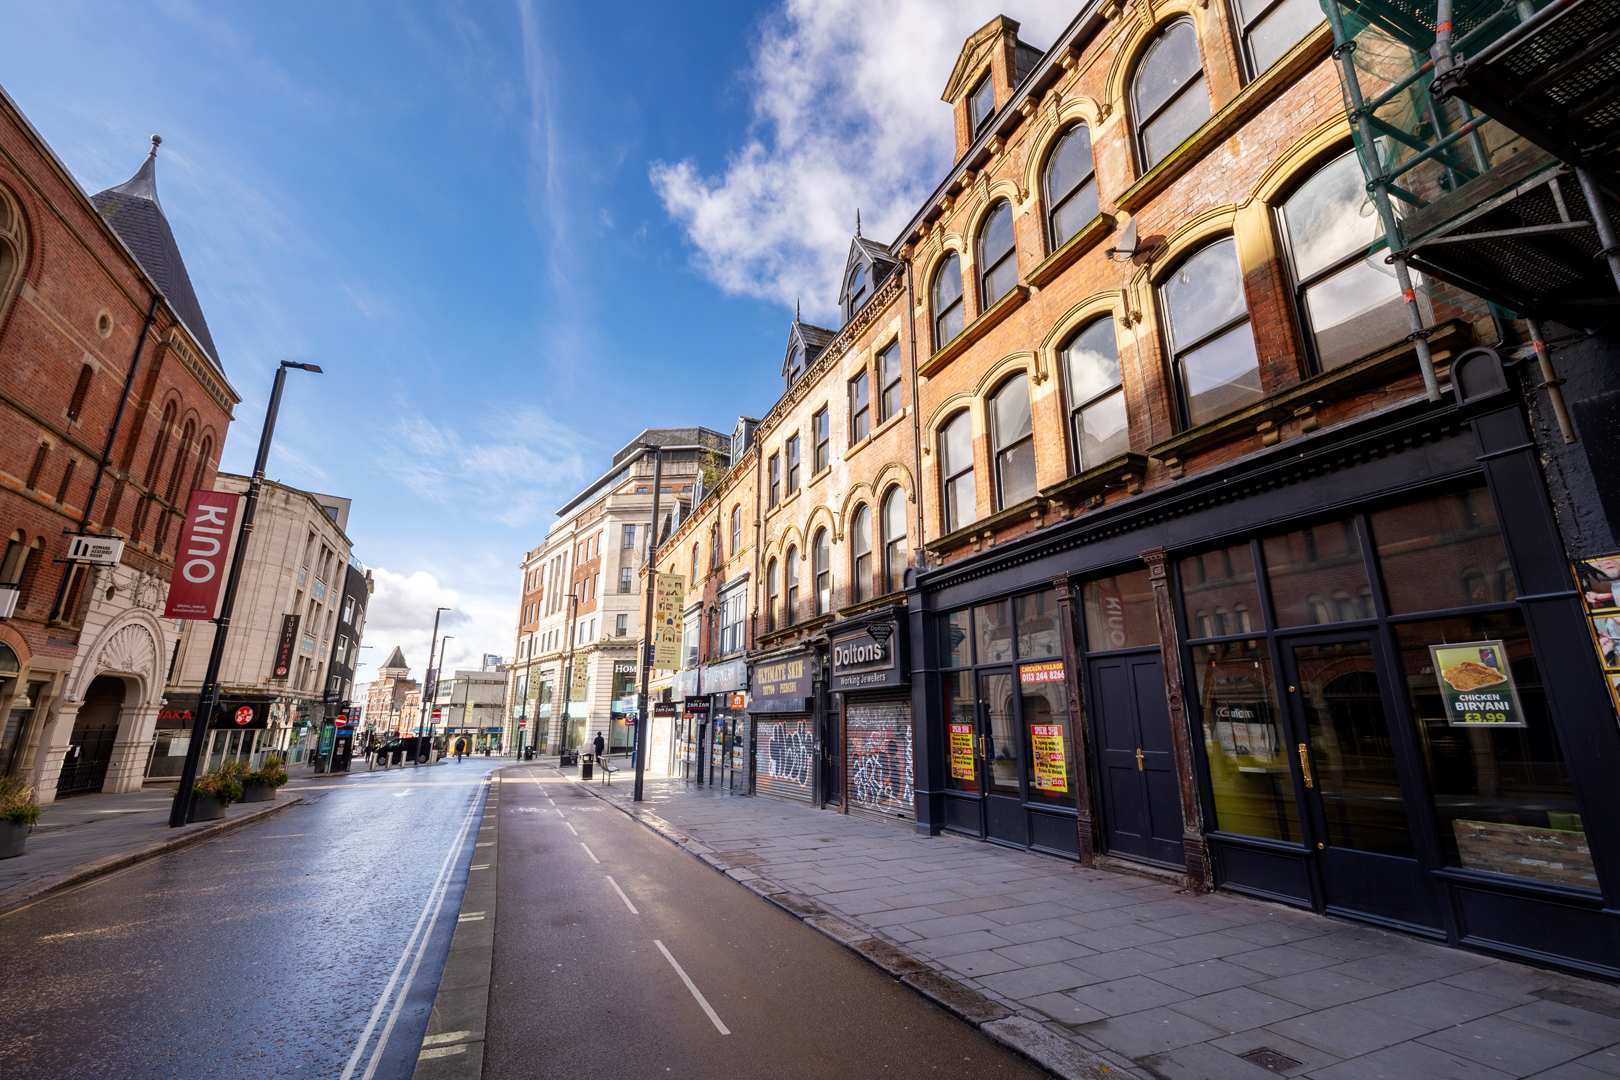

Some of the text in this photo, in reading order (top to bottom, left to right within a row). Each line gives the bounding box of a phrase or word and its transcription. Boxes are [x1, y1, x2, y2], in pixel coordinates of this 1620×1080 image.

[286, 616, 295, 643] SUSHI
[280, 643, 290, 665] WAKA
[835, 644, 882, 666] Doltons
[615, 664, 637, 673] HOM
[758, 664, 786, 684] ULTIMATE
[788, 660, 803, 679] SKIN
[840, 673, 886, 686] Working Jewellers
[1022, 673, 1034, 682] 0113
[1036, 672, 1048, 680] 244
[1455, 702, 1510, 710] BIRYANI
[1465, 713, 1506, 722] £3.99
